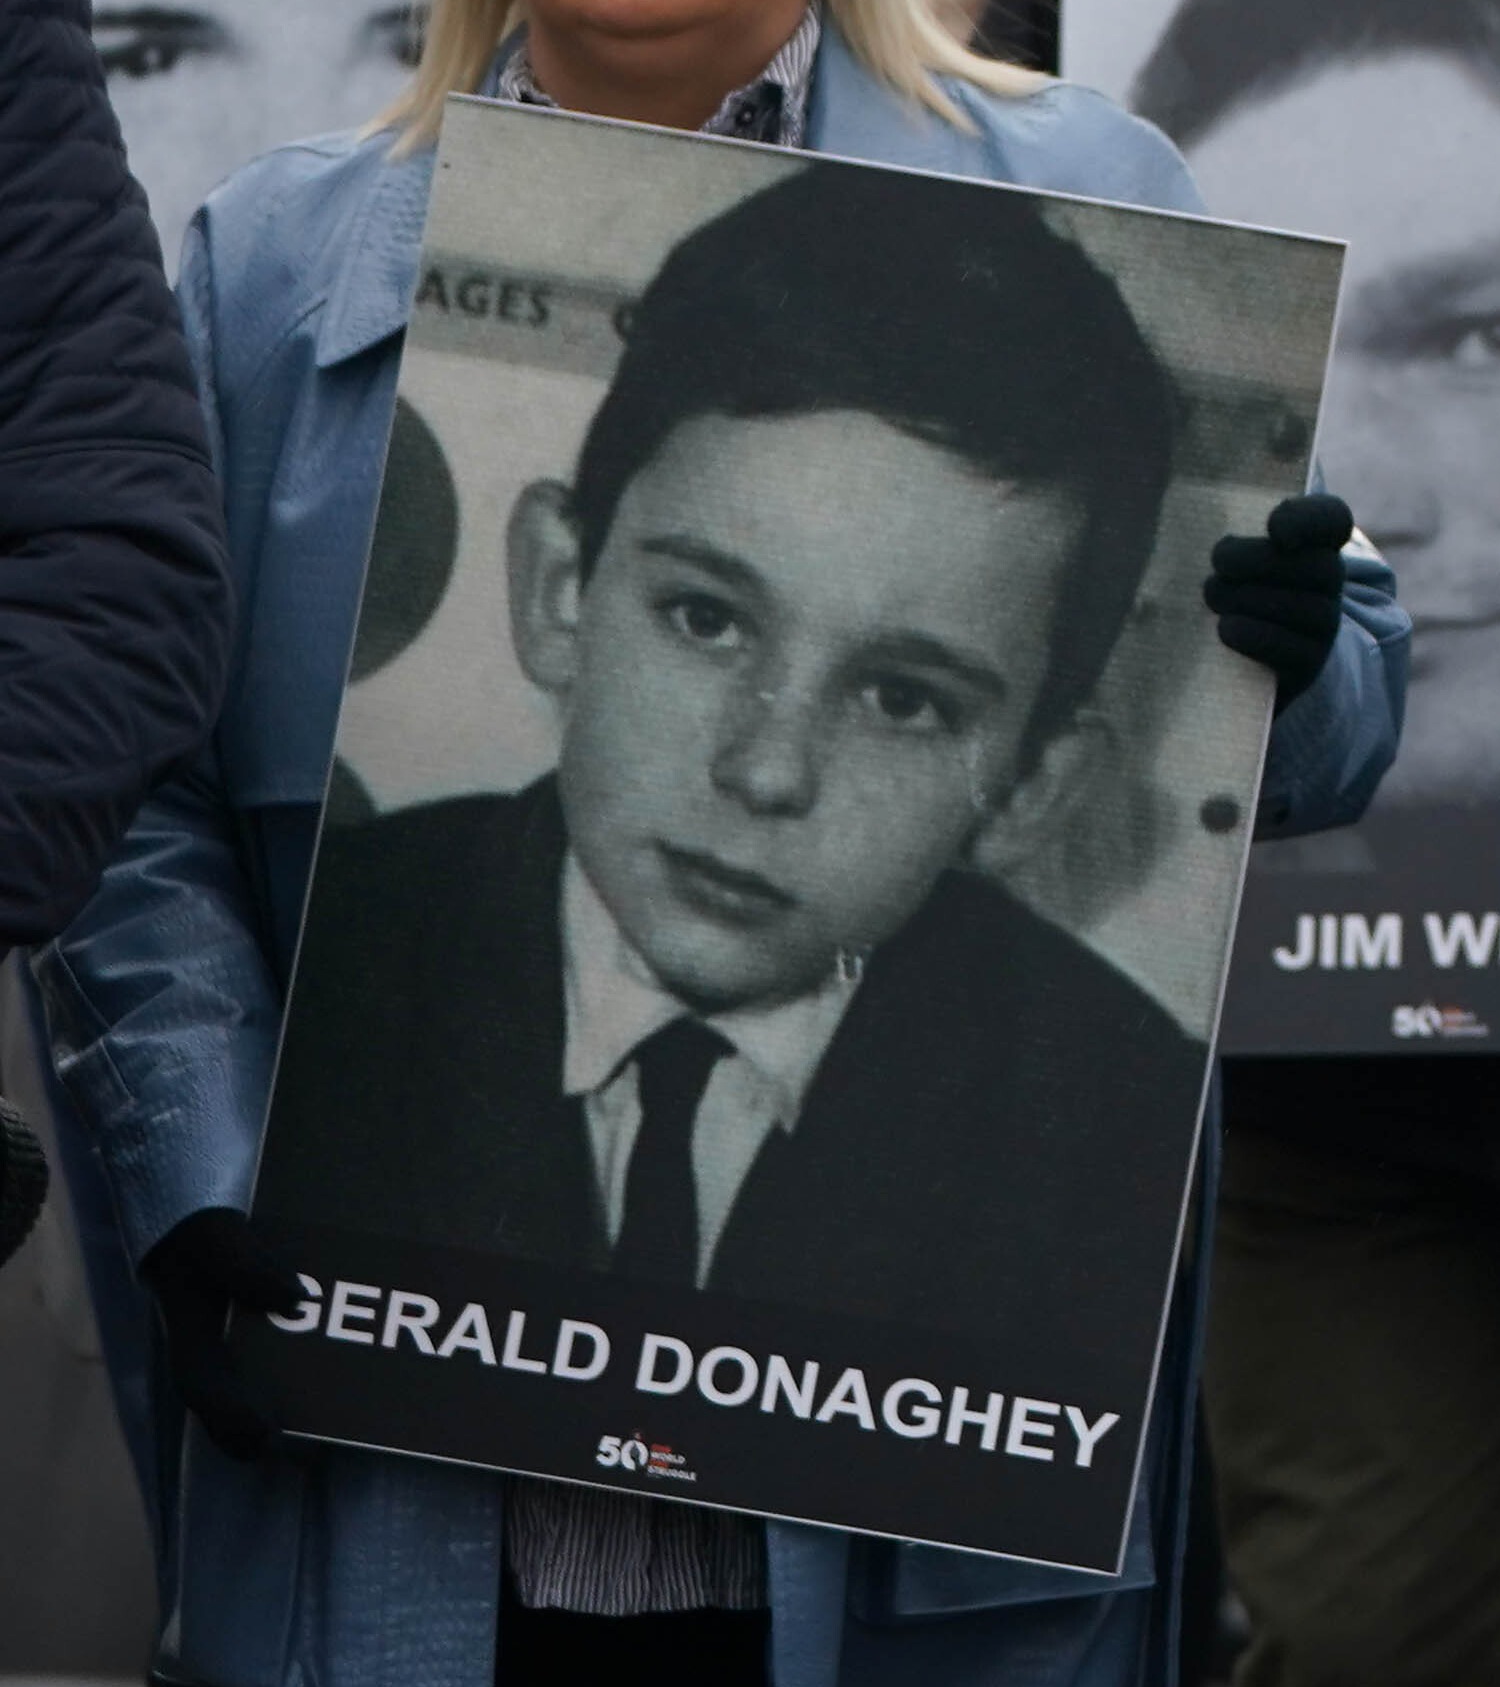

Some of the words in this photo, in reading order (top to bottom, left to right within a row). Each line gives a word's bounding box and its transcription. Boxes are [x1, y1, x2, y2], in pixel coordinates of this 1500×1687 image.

[1273, 913, 1403, 970] JIM
[266, 1272, 611, 1380] GERALD
[635, 1333, 1121, 1468] DONAGHEY
